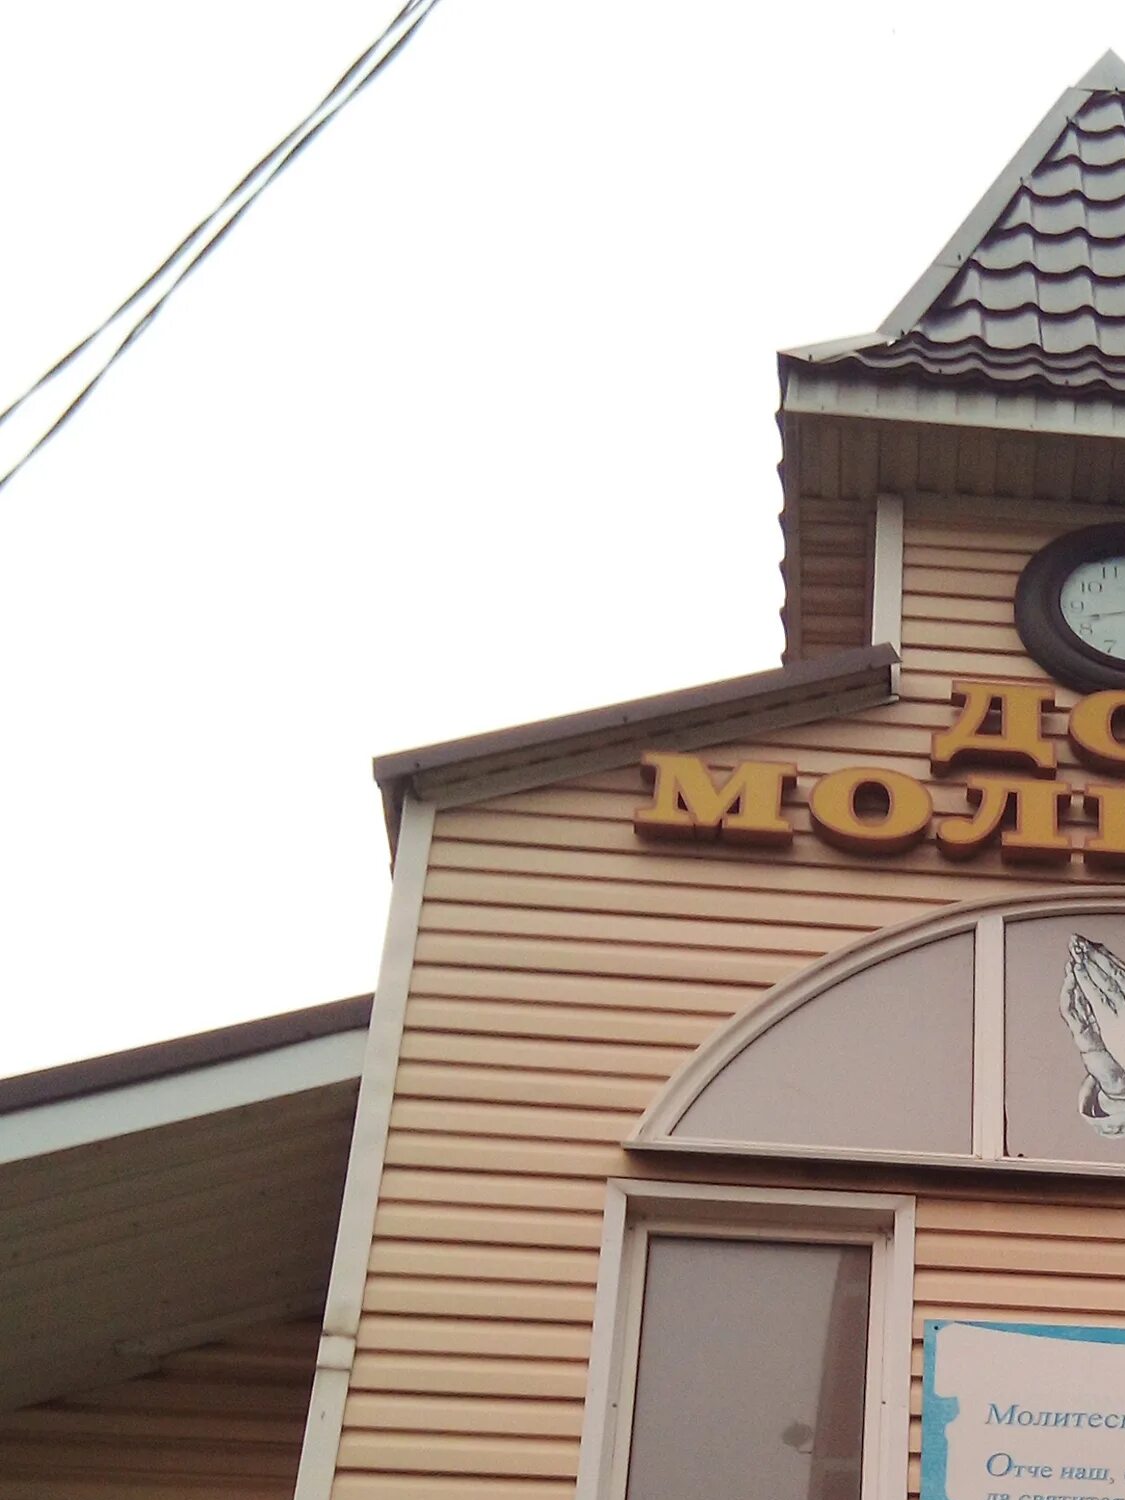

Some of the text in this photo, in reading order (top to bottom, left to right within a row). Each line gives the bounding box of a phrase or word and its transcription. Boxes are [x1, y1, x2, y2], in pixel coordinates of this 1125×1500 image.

[1102, 565, 1118, 579] 11
[1081, 581, 1102, 593] 10
[1070, 600, 1084, 613] 9
[1079, 623, 1093, 635] 8
[1104, 639, 1116, 653] 7
[985, 1452, 1054, 1479] Отче
[1059, 1466, 1115, 1485] наш,
